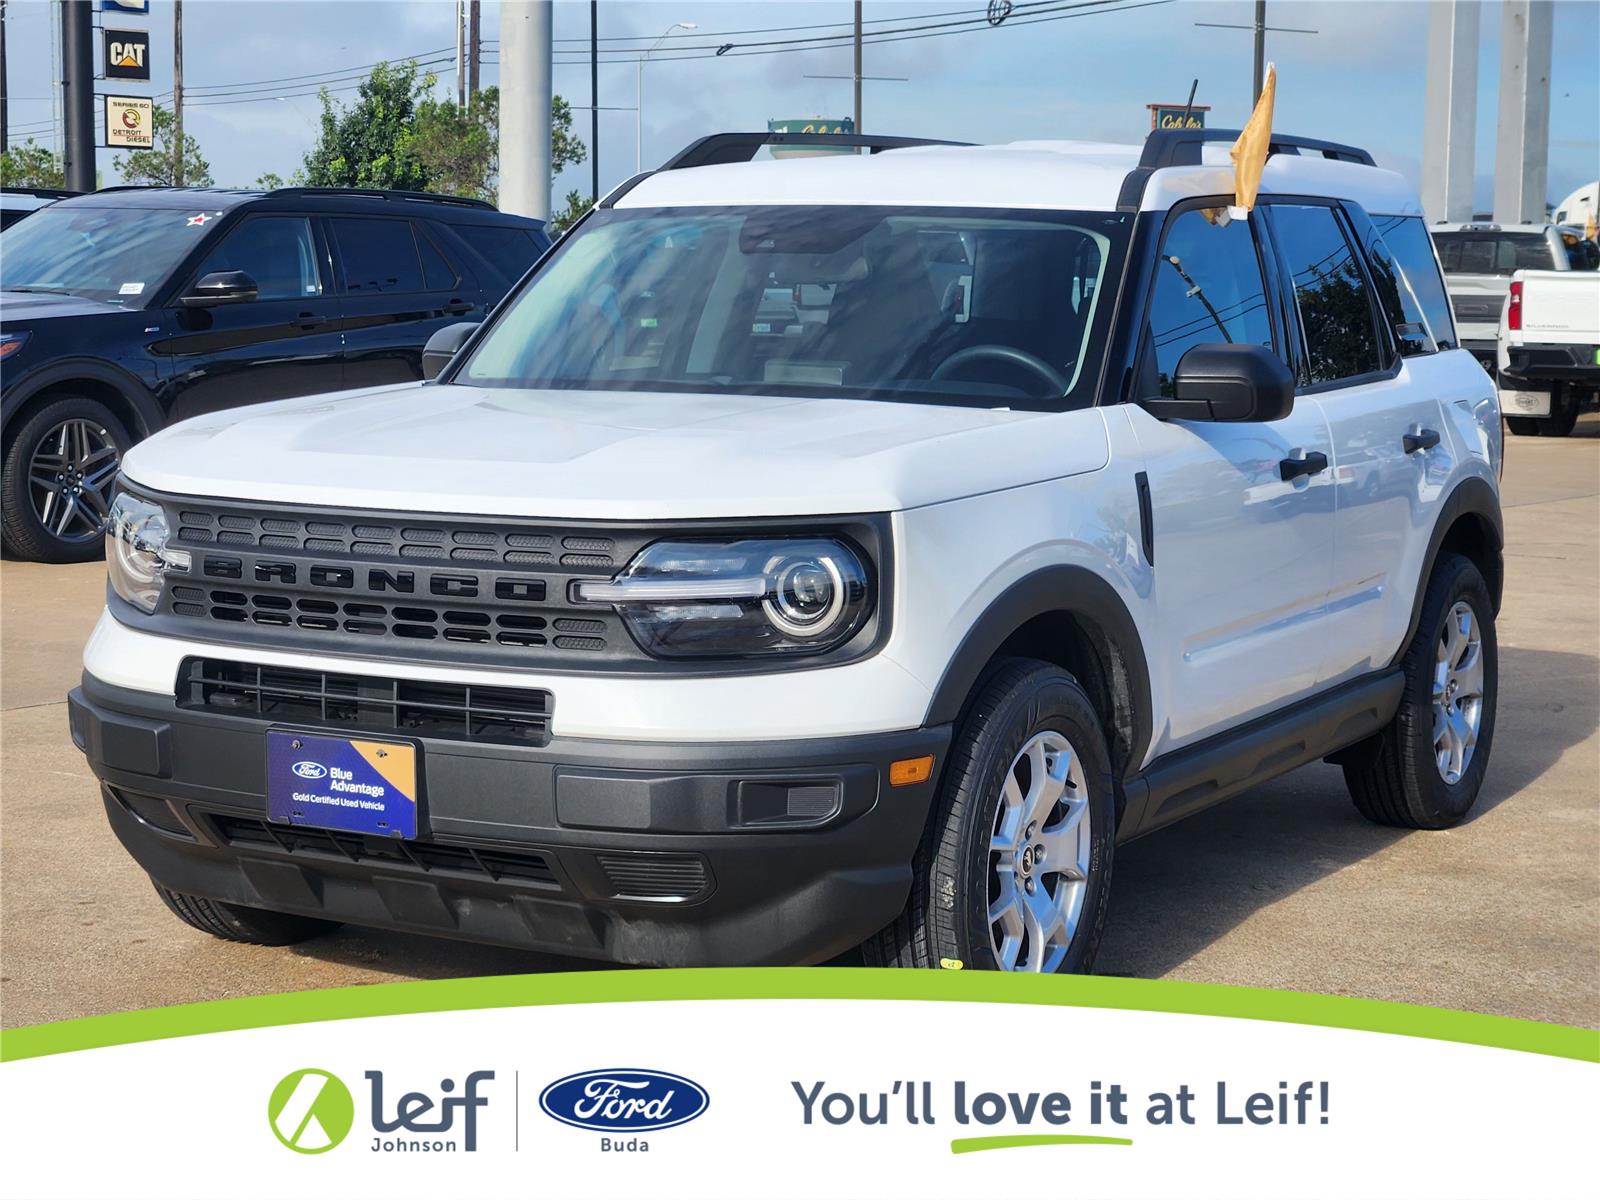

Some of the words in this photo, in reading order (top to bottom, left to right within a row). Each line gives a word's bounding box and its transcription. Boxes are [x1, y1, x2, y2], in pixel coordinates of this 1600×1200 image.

[110, 42, 146, 67] CAT
[203, 554, 547, 601] BRONCO
[298, 763, 321, 776] Ford
[330, 767, 353, 780] Blue
[330, 780, 385, 797] Advantage
[292, 792, 310, 802] Gold
[310, 794, 340, 806] Certified
[340, 798, 359, 808] Used
[359, 801, 385, 811] Vehicle
